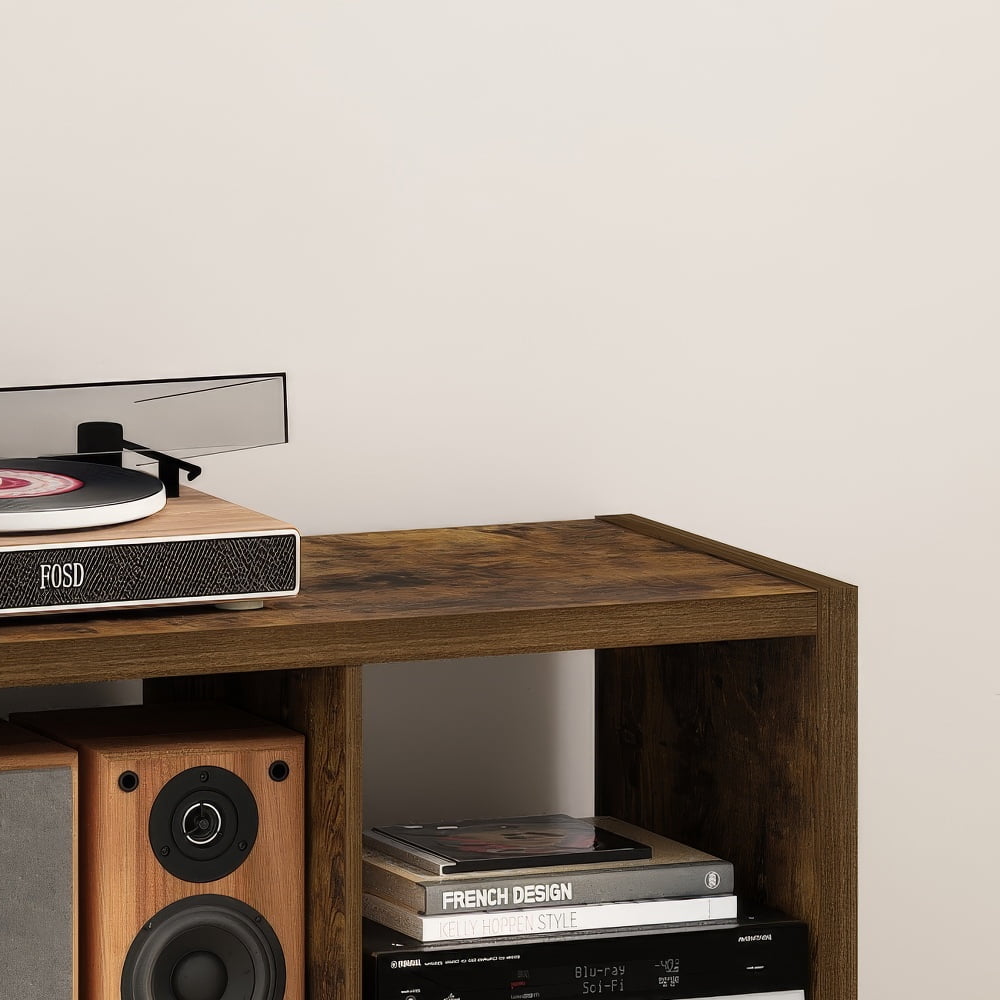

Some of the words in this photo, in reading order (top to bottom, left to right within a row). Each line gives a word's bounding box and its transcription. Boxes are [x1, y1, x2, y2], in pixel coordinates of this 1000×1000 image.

[39, 562, 85, 590] FOSD
[442, 887, 509, 910] FRENCH
[513, 882, 573, 905] DESIGN
[439, 920, 478, 938] KELLY
[482, 915, 534, 936] HOPPEN
[537, 911, 578, 931] STYLE
[575, 965, 625, 979] Blu-ray
[582, 979, 624, 995] Sci-Fi
